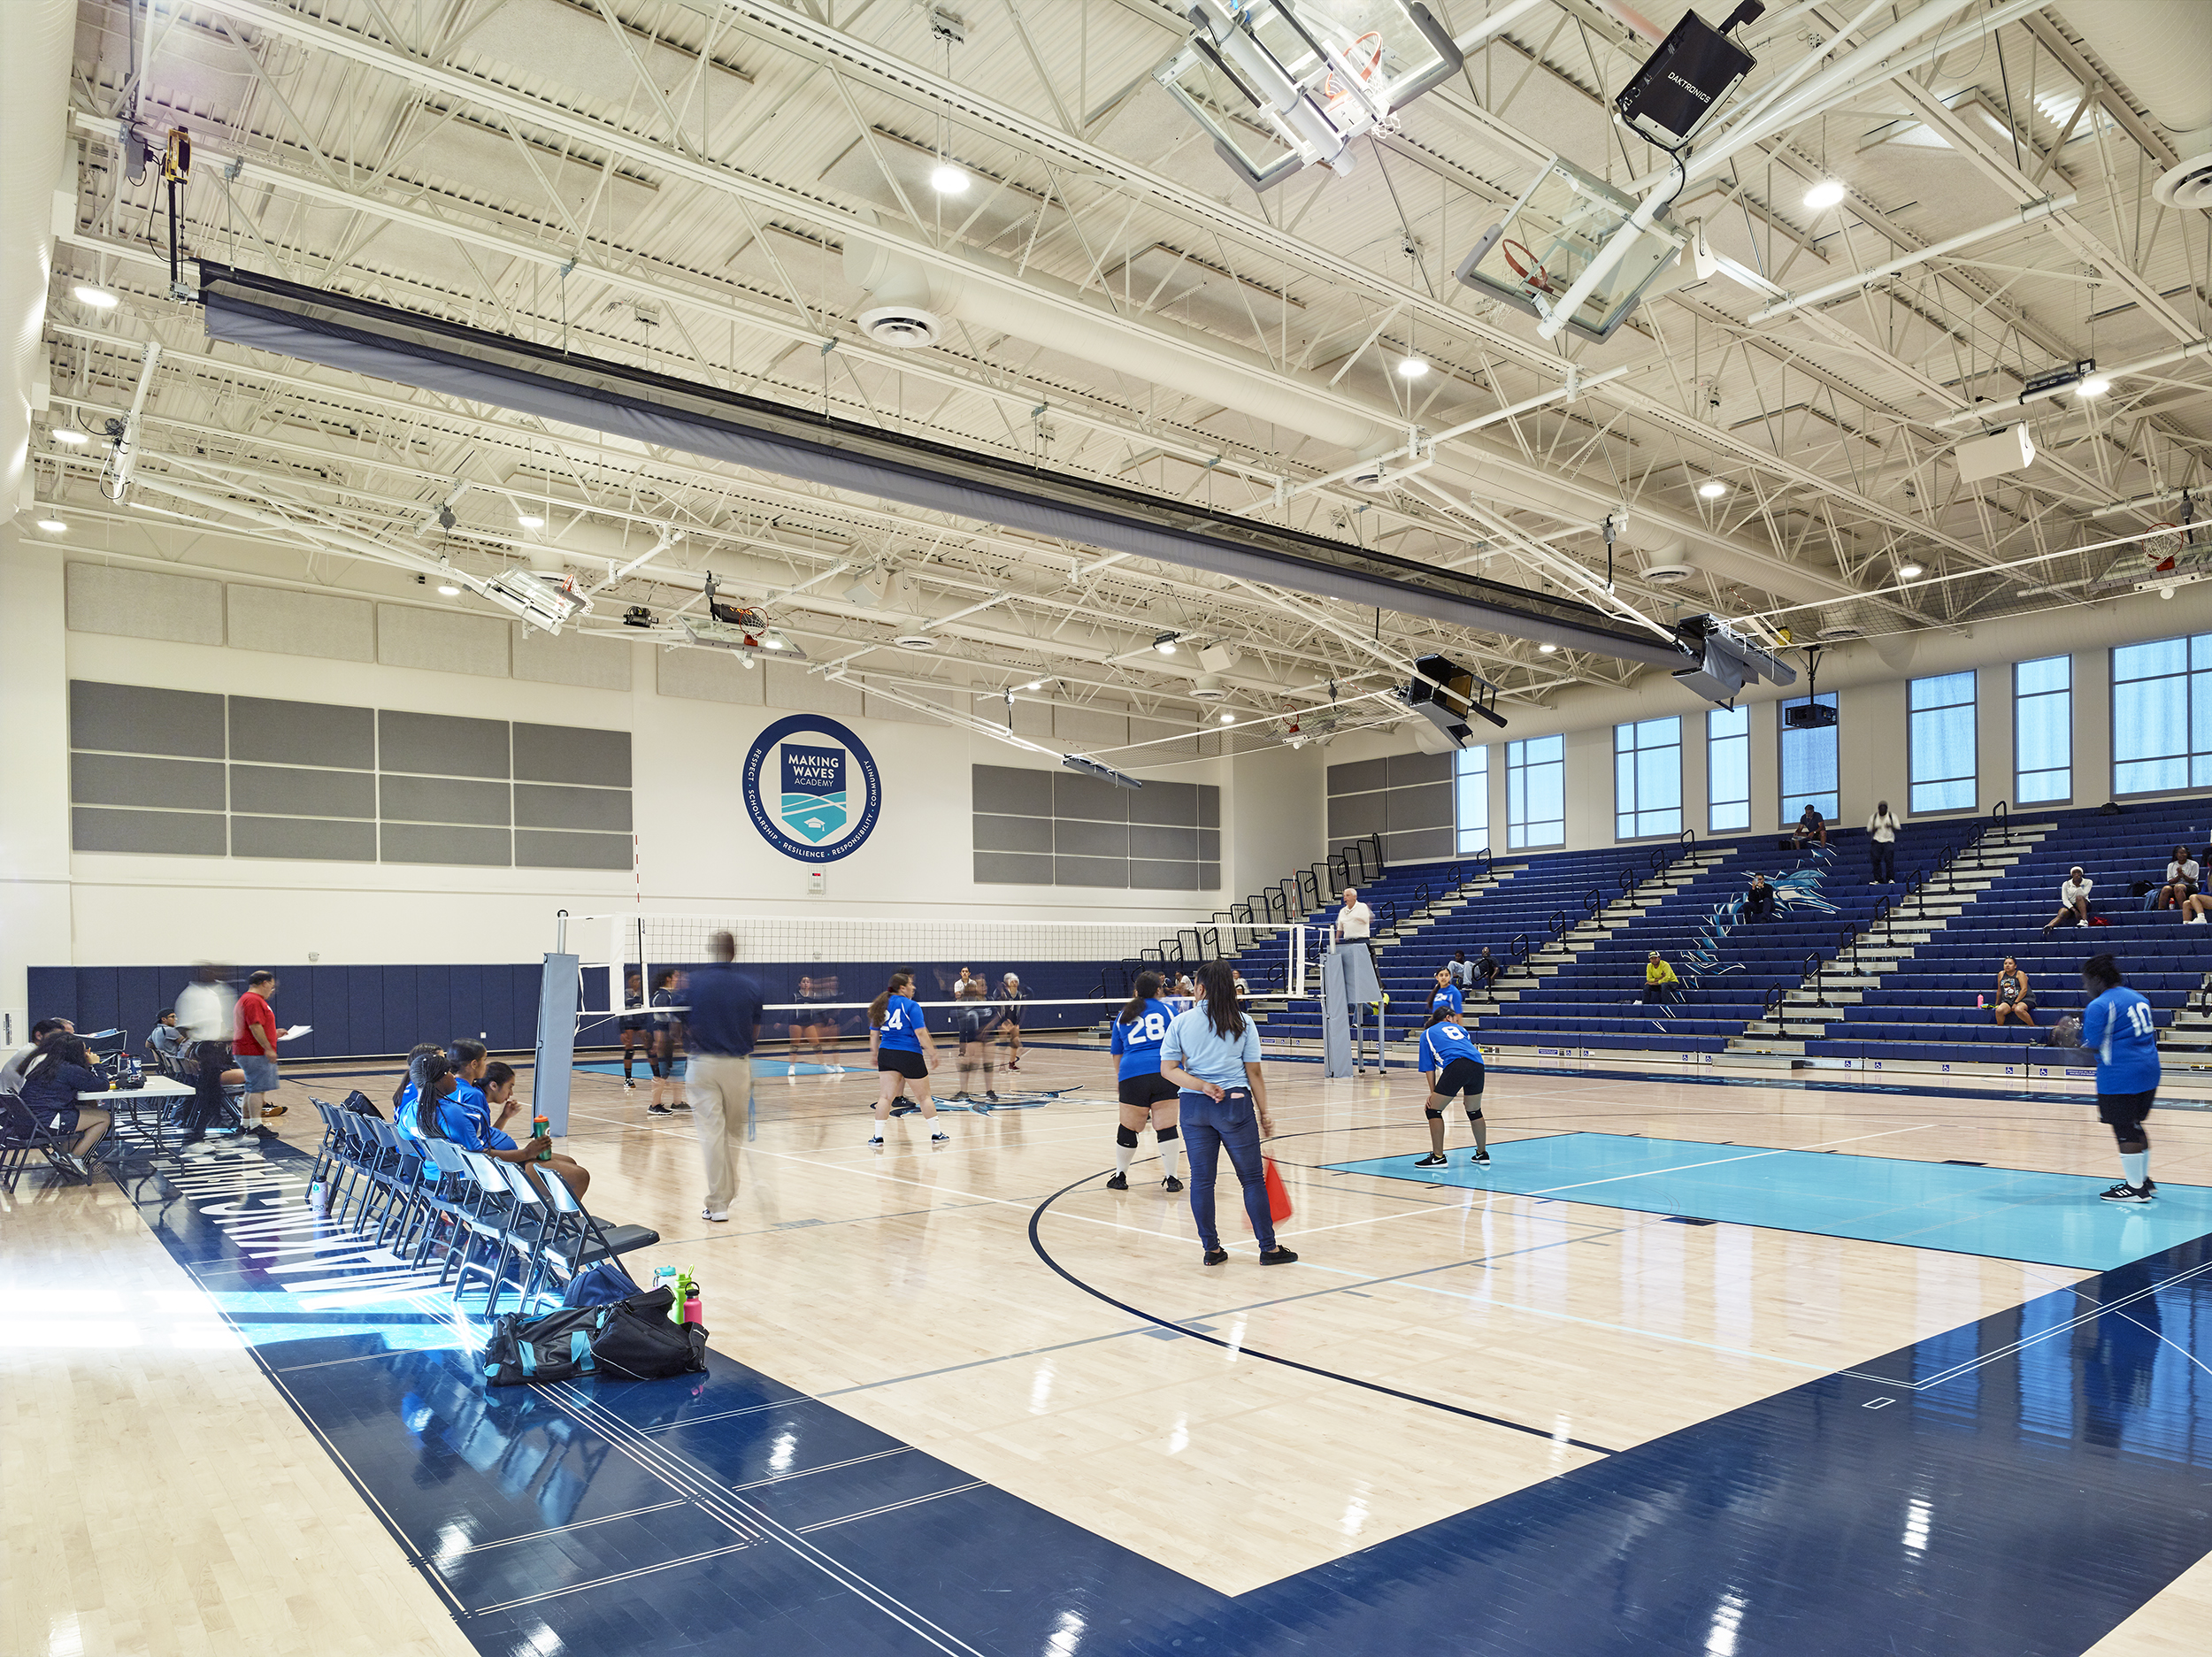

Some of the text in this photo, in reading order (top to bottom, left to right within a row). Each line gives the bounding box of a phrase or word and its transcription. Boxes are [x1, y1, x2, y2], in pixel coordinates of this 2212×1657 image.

[1668, 72, 1711, 104] DAKTRONICS
[788, 754, 839, 768] MAKING
[793, 766, 834, 779] WAVES
[795, 778, 833, 787] ACADEMY
[748, 748, 877, 858] RESPECT SCHOLARSHIP RESILIENCE RESPONSIBILITY COMMUNITY
[879, 1009, 902, 1031] 24
[1126, 1013, 1165, 1045] 28
[2126, 1001, 2154, 1037] 10
[1441, 1026, 1464, 1040] 8
[199, 1194, 490, 1310] MAKING
